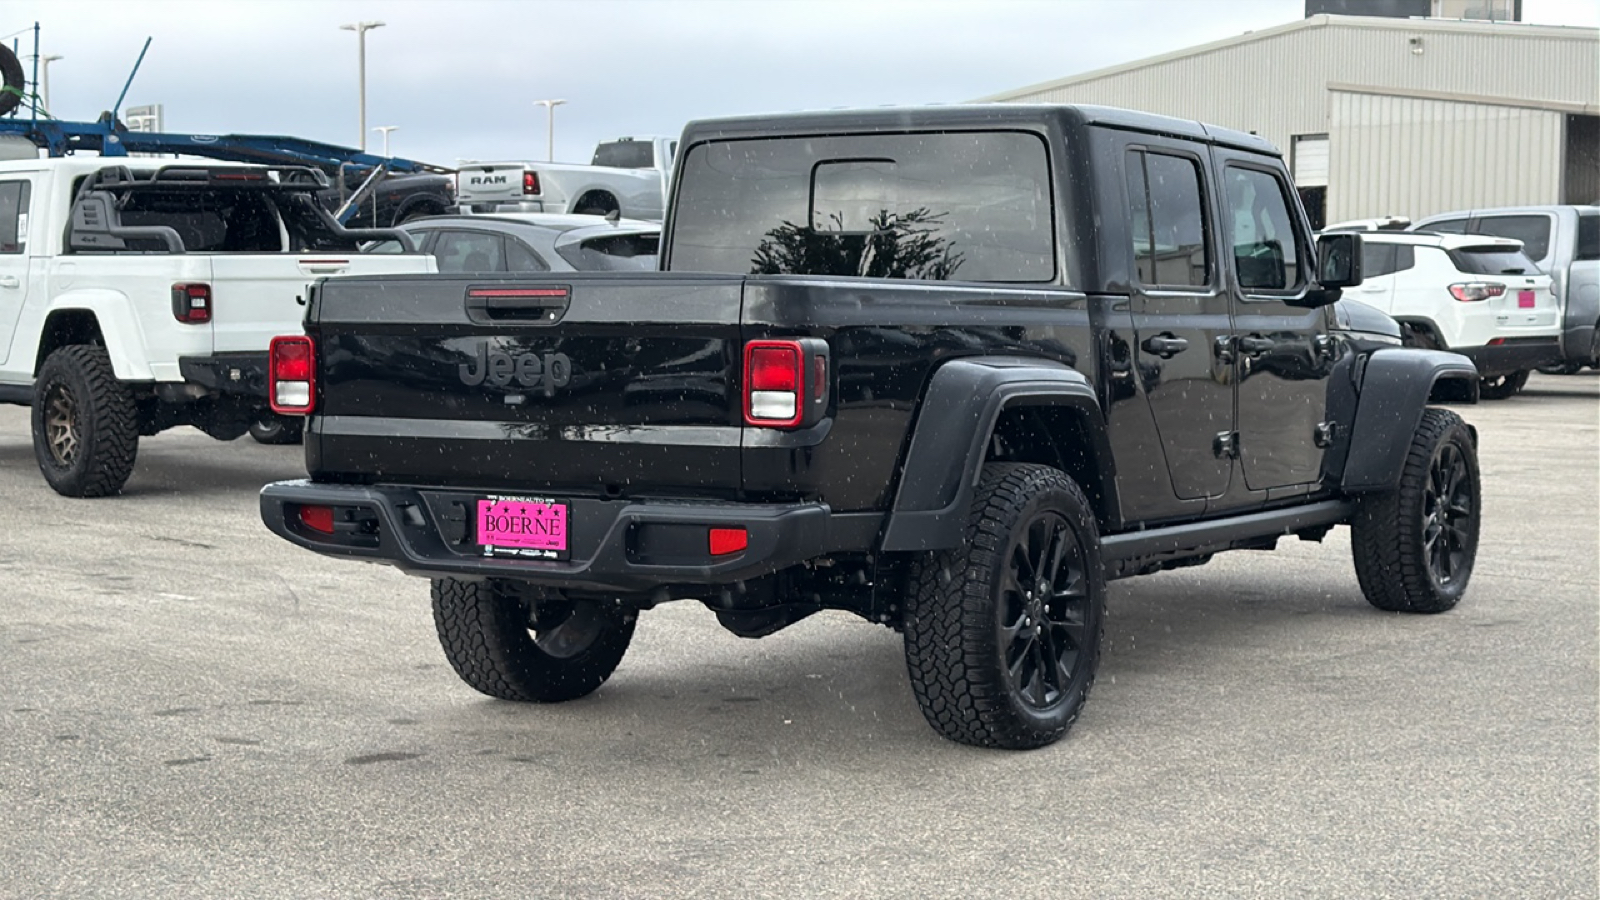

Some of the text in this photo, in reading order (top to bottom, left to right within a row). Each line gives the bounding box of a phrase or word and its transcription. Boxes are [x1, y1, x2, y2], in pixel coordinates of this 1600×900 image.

[470, 175, 507, 185] RAM
[458, 341, 572, 397] Jeep
[485, 514, 561, 536] BOERNE
